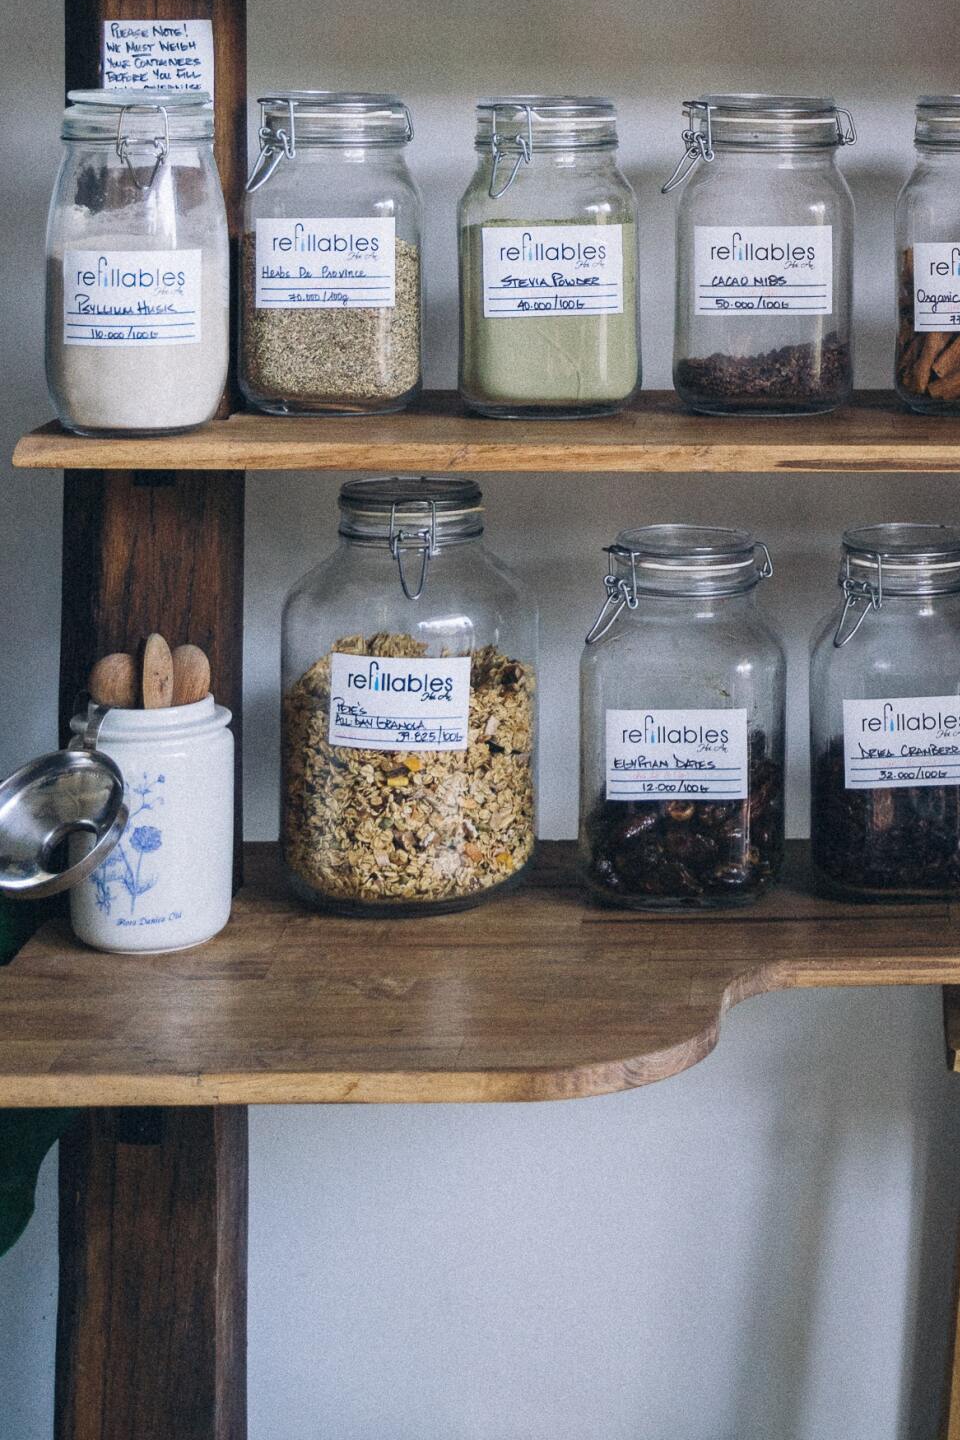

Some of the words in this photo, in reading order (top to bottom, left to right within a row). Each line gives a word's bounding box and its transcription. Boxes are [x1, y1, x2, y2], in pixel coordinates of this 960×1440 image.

[111, 23, 149, 39] PLEASE
[153, 24, 188, 37] NOTE!
[106, 42, 120, 53] WE
[126, 42, 155, 53] MUST
[159, 41, 196, 51] WEIGH
[134, 58, 201, 69] CONTAINERS
[106, 71, 148, 82] BEFORE
[153, 69, 171, 80] YOU
[177, 68, 201, 78] FILL
[273, 223, 379, 251] refillables
[500, 233, 606, 261] refillables
[711, 232, 815, 260] refillables
[77, 257, 185, 287] refillables
[262, 266, 291, 278] Herbs
[501, 275, 548, 287] STEVIA
[551, 272, 600, 287] POWDER
[712, 276, 748, 286] CACAO
[754, 275, 787, 286] NIBS
[137, 300, 177, 315] HUSK
[917, 289, 960, 313] Organic
[348, 661, 453, 692] refillables
[623, 715, 728, 743] refillables
[673, 754, 716, 770] DATES
